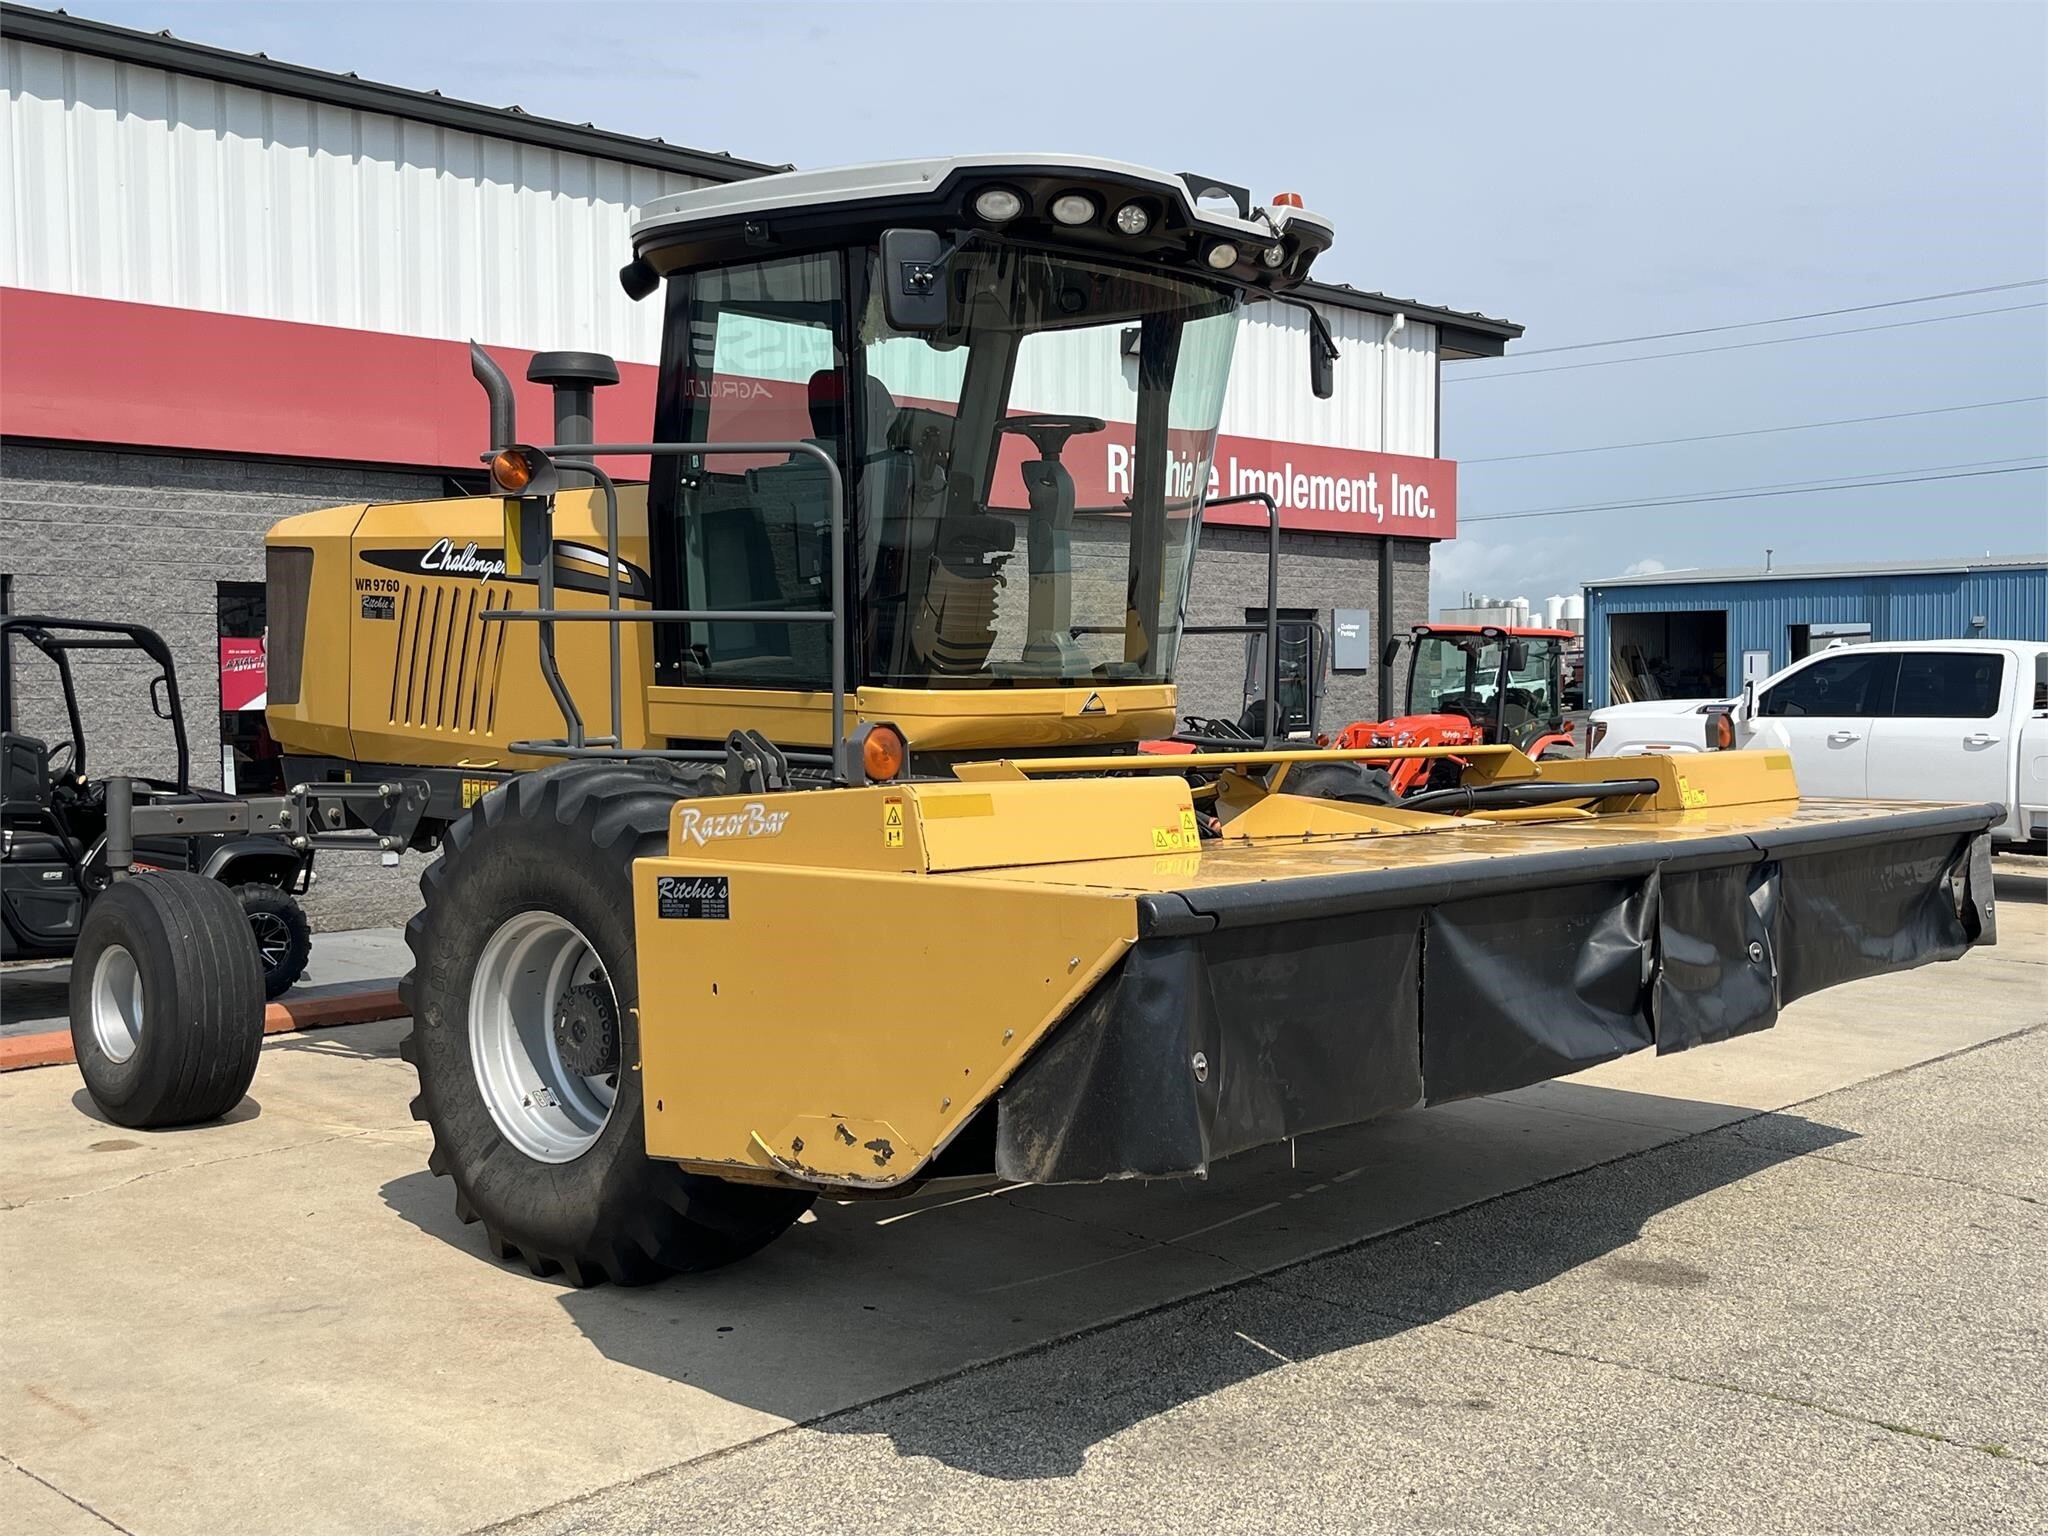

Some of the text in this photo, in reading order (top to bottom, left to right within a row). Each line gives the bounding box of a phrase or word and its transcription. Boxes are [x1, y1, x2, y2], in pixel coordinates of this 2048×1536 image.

[1229, 456, 1384, 523] Implement,
[1391, 473, 1436, 519] Inc.
[658, 877, 729, 899] Ritchie's
